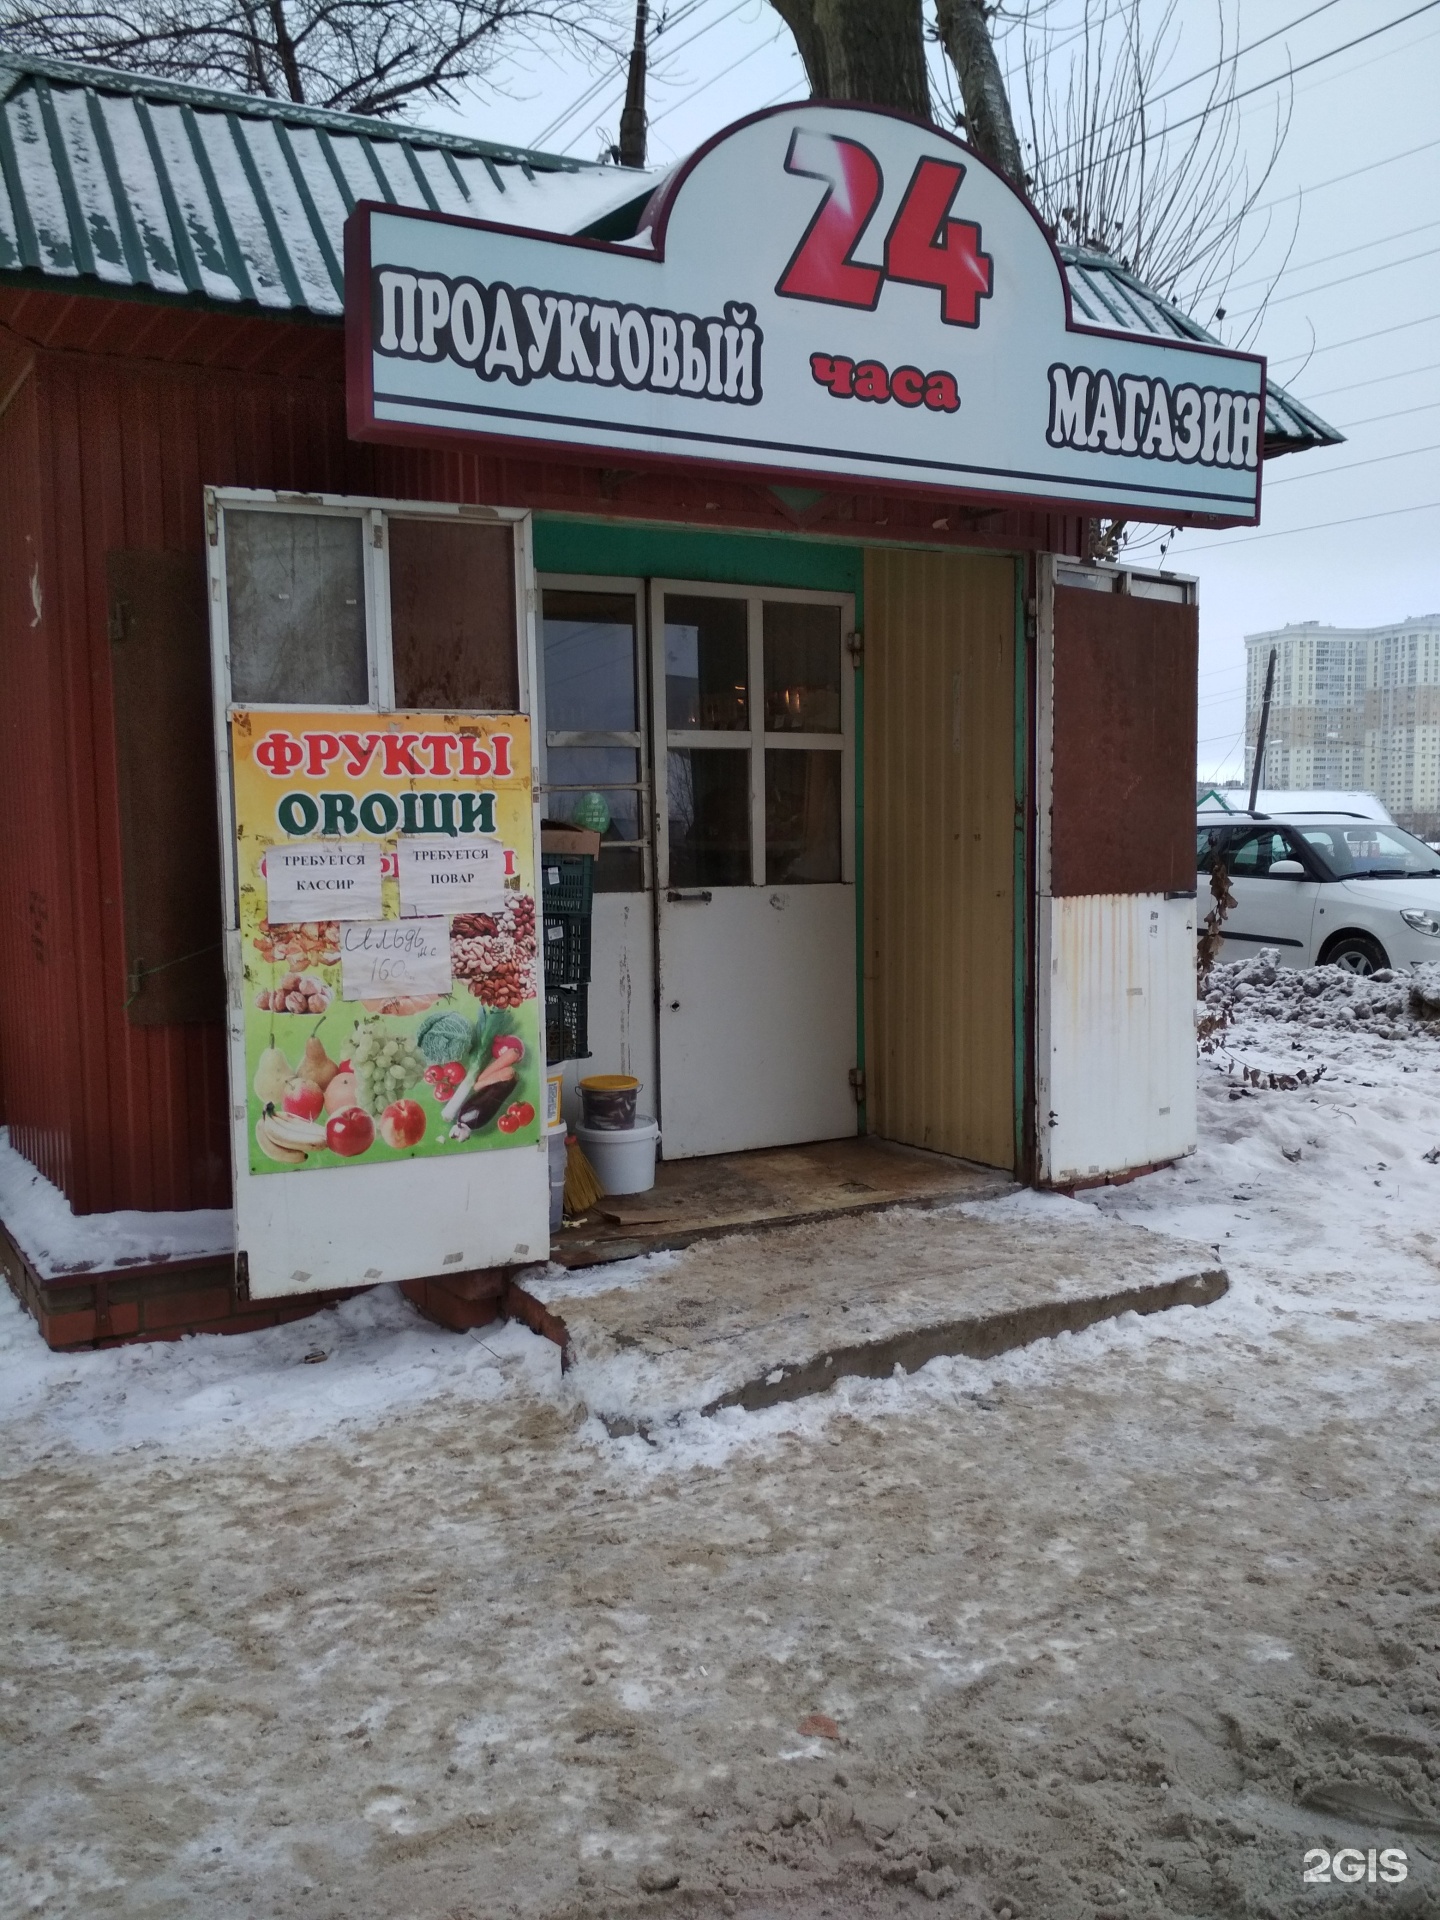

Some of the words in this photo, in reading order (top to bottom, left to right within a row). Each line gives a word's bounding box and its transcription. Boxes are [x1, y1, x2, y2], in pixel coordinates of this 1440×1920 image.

[774, 126, 994, 330] 24
[373, 265, 763, 405] ПРОДУКТОВЫЙ
[809, 351, 961, 414] часа
[1046, 362, 1261, 472] МАГАЗИН
[256, 732, 513, 777] ФРУКТЫ
[277, 792, 497, 838] ОВОЩИ
[282, 854, 366, 867] ТРЕБУЕТСЯ
[413, 848, 489, 861] ТРЕБУЕТСЯ
[296, 879, 355, 891] КАССИР
[430, 873, 475, 885] ПОВАР
